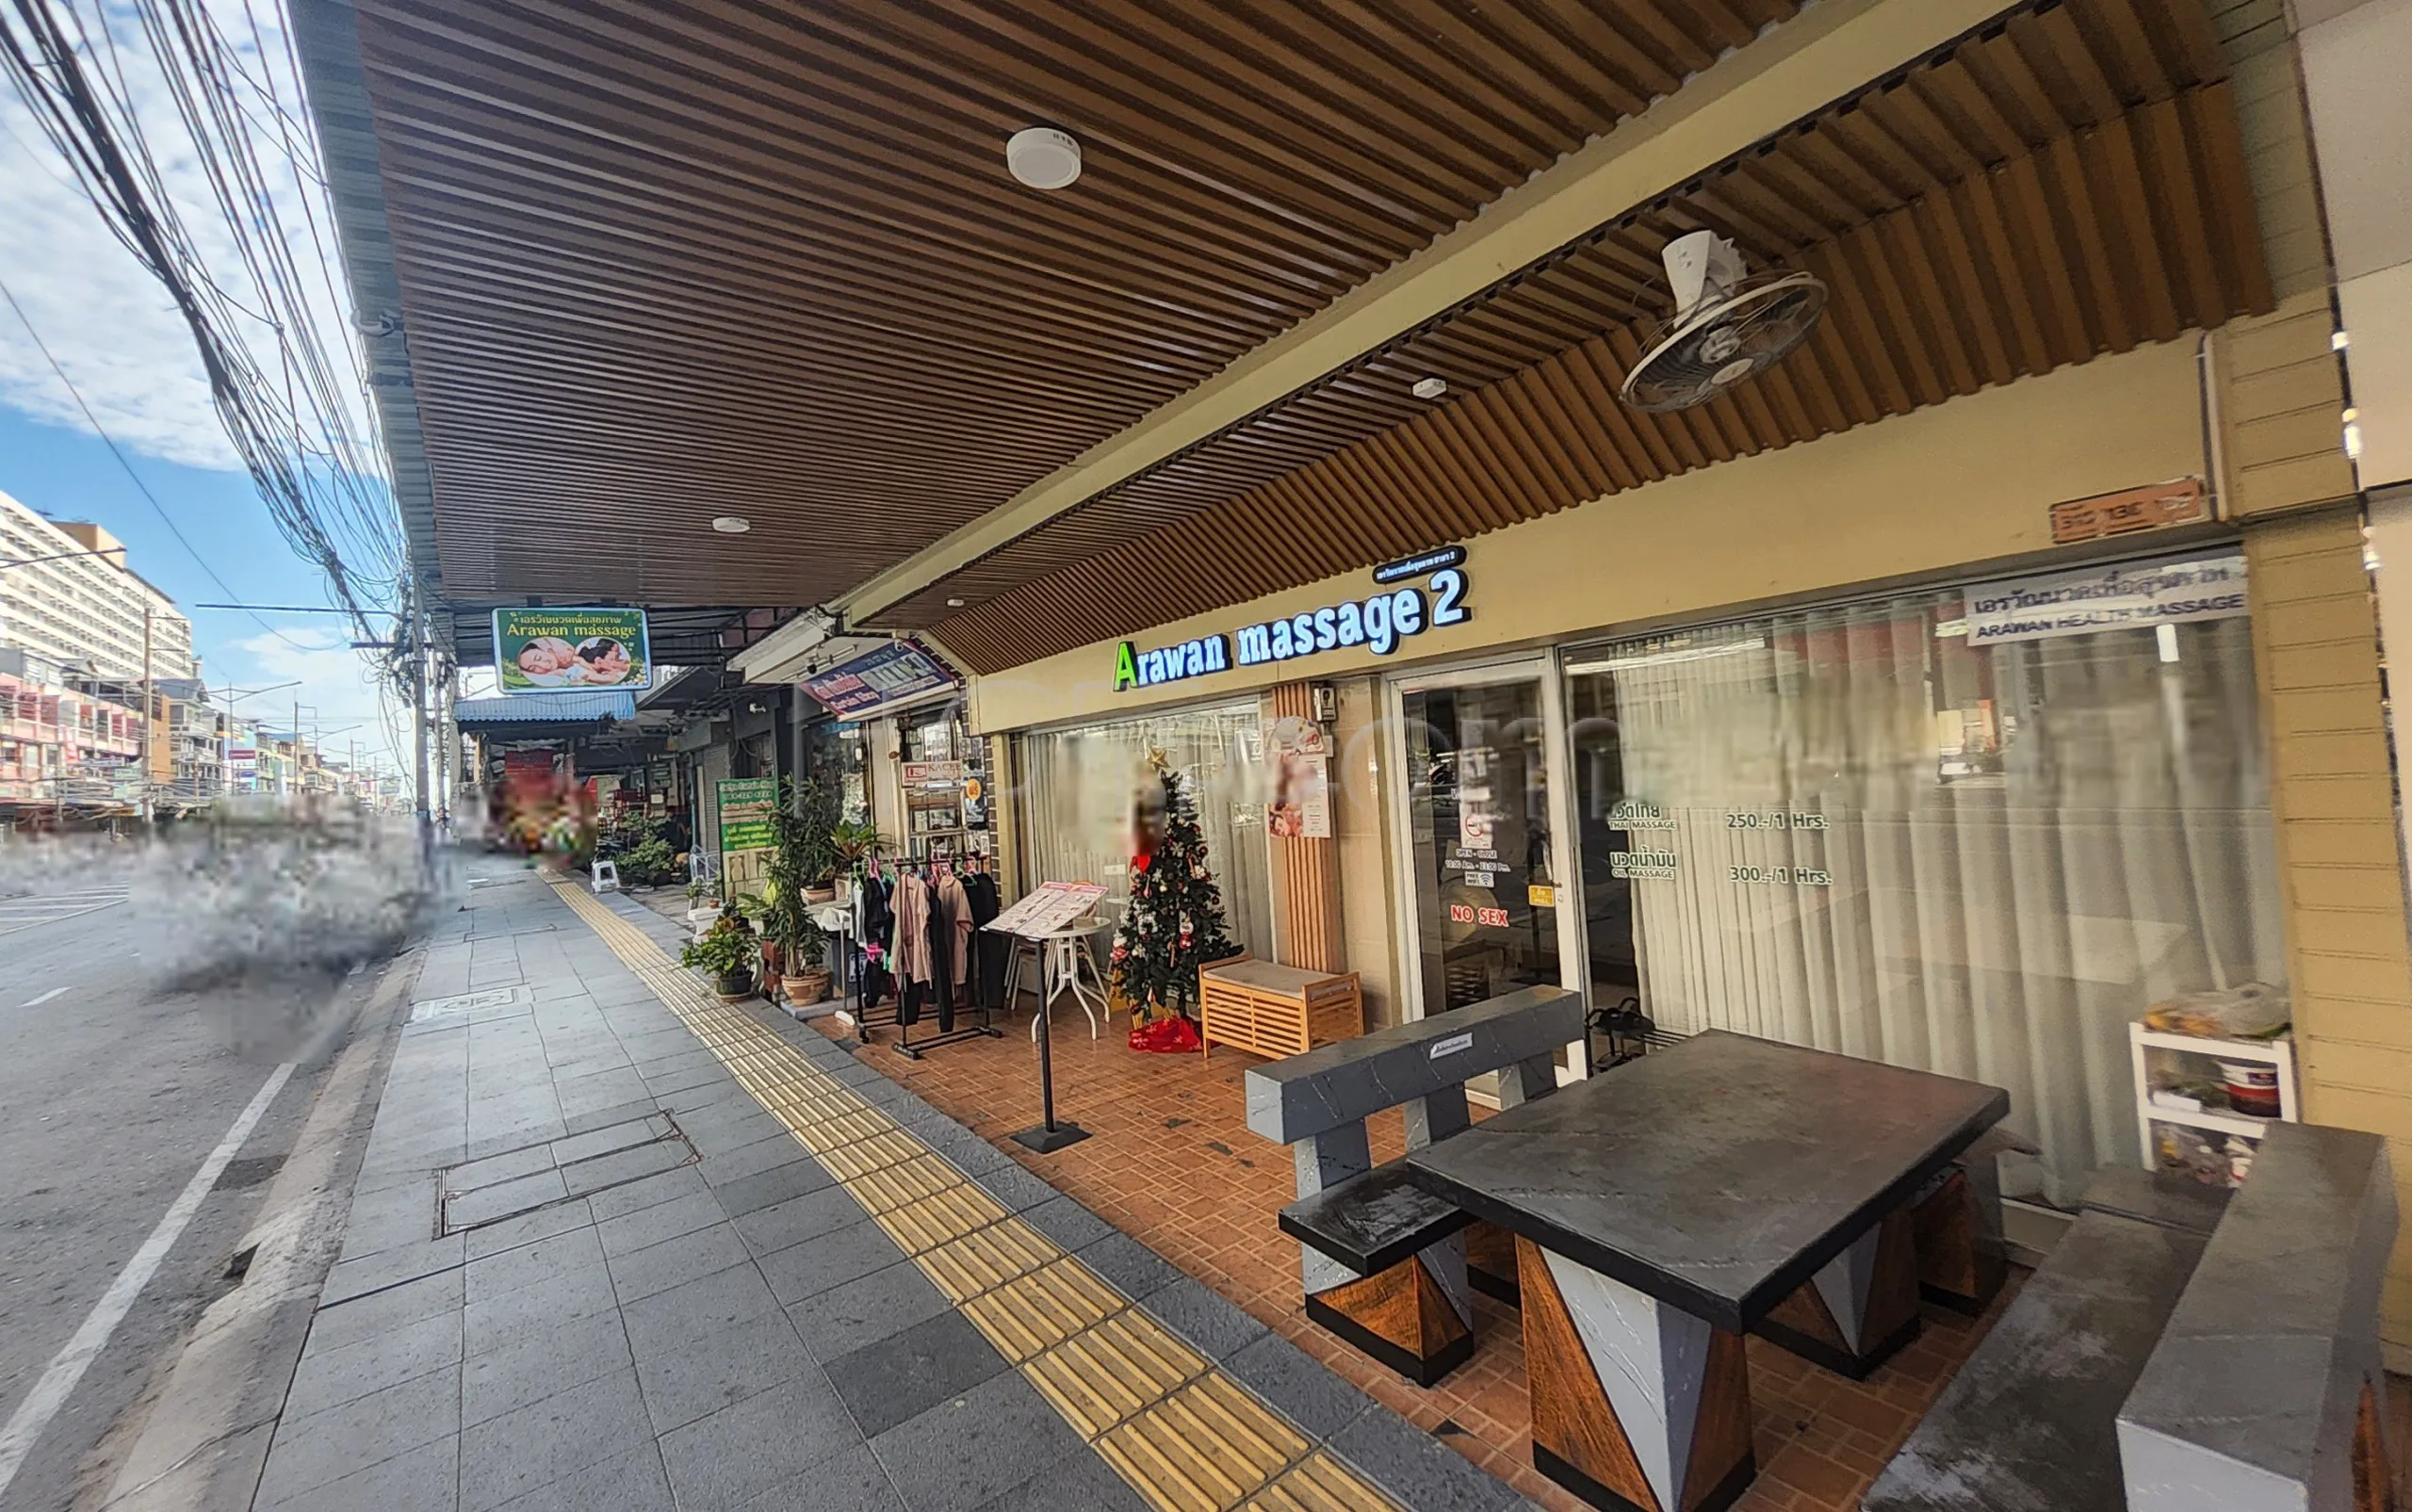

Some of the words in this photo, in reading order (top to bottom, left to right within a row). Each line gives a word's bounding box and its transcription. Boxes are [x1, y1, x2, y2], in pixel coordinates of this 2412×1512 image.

[1449, 551, 1456, 561] 2
[507, 624, 568, 637] Arawan
[574, 626, 636, 640] massage
[1113, 633, 1226, 691] Arawan
[1237, 588, 1421, 655] massage
[1429, 568, 1463, 626] 2
[1977, 619, 2053, 639] ARAWAN
[1632, 821, 1676, 829] MASSAGE
[1792, 813, 1829, 828] Hrs.
[1456, 849, 1473, 857] OPEN
[1477, 850, 1497, 859] CLOSE
[1611, 845, 1676, 868] นวดน้ำมัน
[1612, 869, 1627, 877] OIL
[1630, 870, 1673, 879] MASSAGE
[1795, 869, 1833, 884] Hrs.
[1451, 905, 1474, 922] NO
[1478, 907, 1509, 927] SEX
